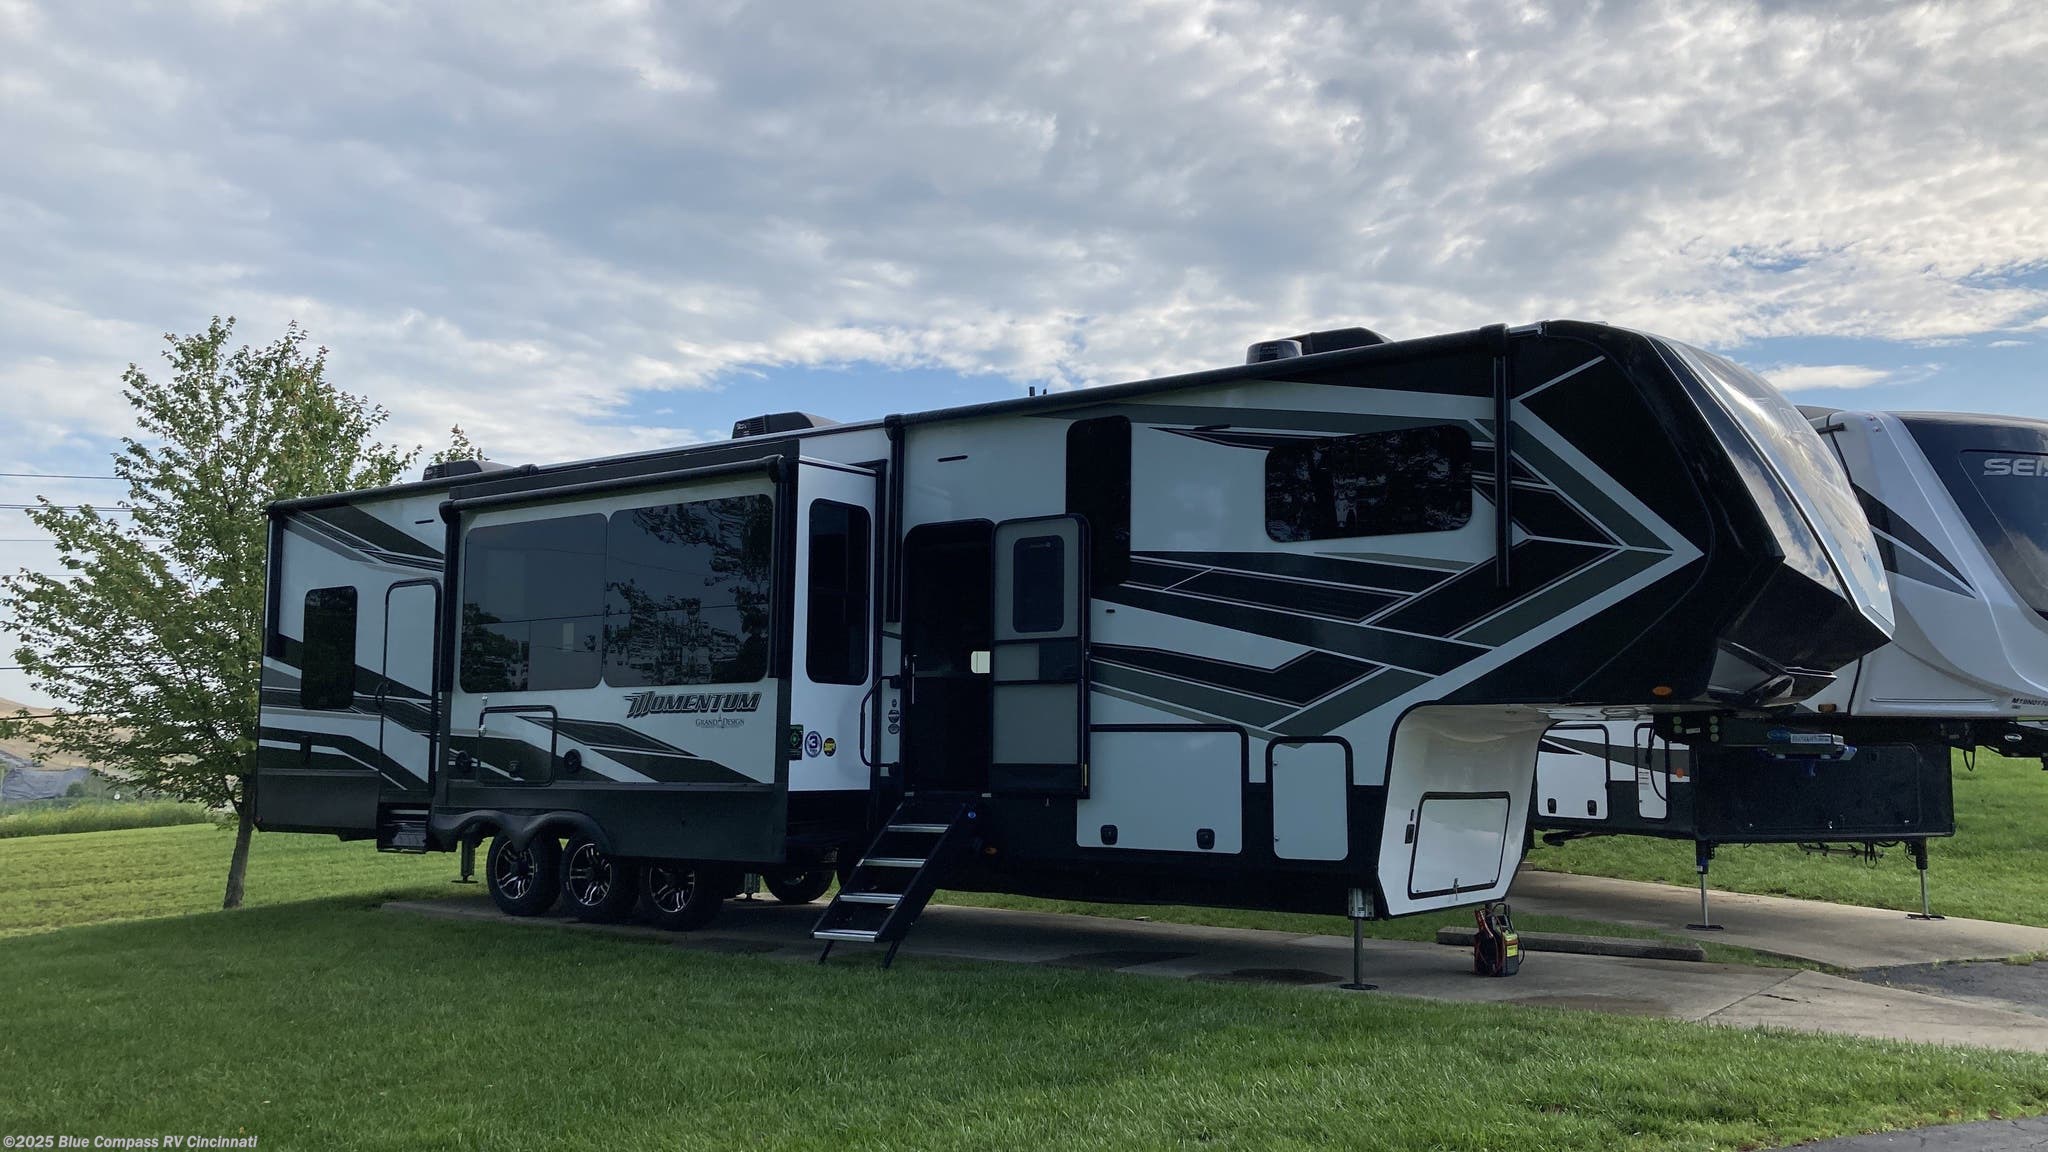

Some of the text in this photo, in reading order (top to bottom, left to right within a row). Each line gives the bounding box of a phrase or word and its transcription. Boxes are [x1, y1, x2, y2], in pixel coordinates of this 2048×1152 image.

[1983, 458, 2048, 477] SEI
[623, 690, 762, 718] MOMENTUM
[808, 735, 818, 749] 3
